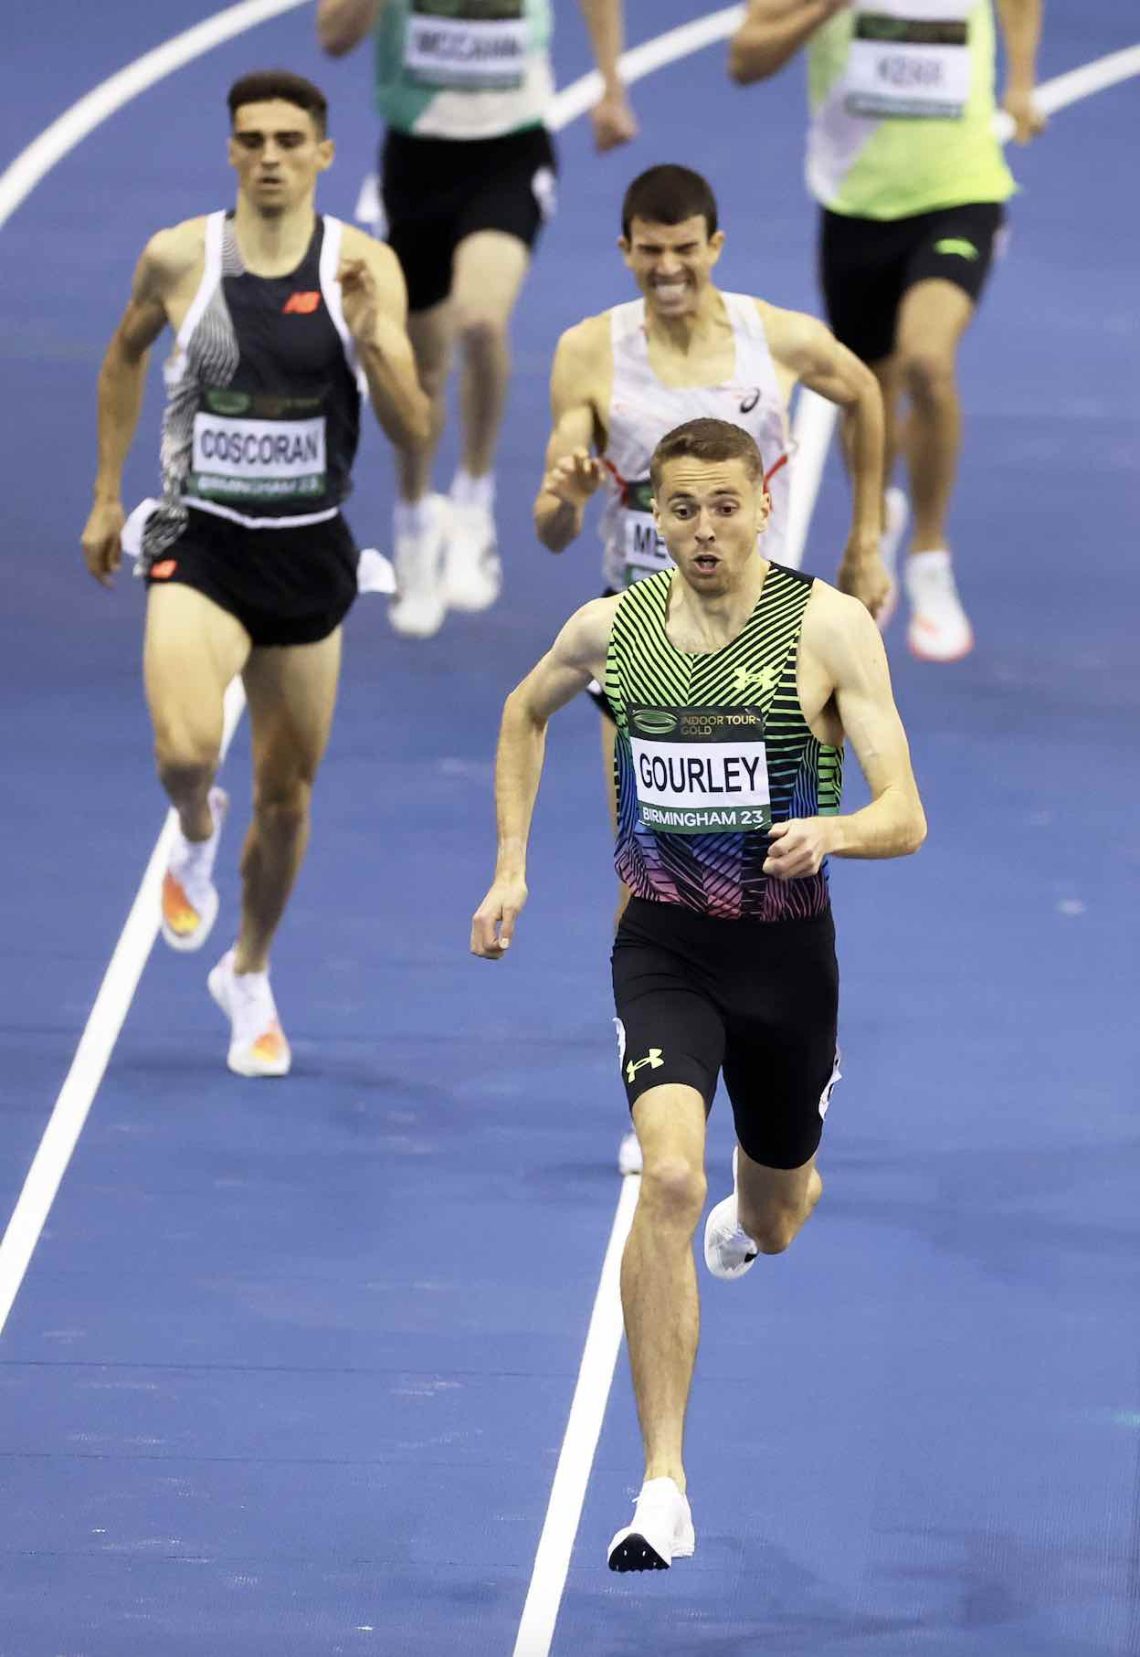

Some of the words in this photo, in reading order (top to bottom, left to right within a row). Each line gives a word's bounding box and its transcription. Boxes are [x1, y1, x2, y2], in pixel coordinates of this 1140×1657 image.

[201, 428, 319, 465] COSCORAN
[633, 524, 667, 560] ME
[681, 725, 713, 736] GOLD
[725, 714, 757, 726] TOUR
[639, 752, 760, 793] GOURLEY
[642, 806, 737, 827] BIRMINGHAM
[740, 809, 764, 825] 23
